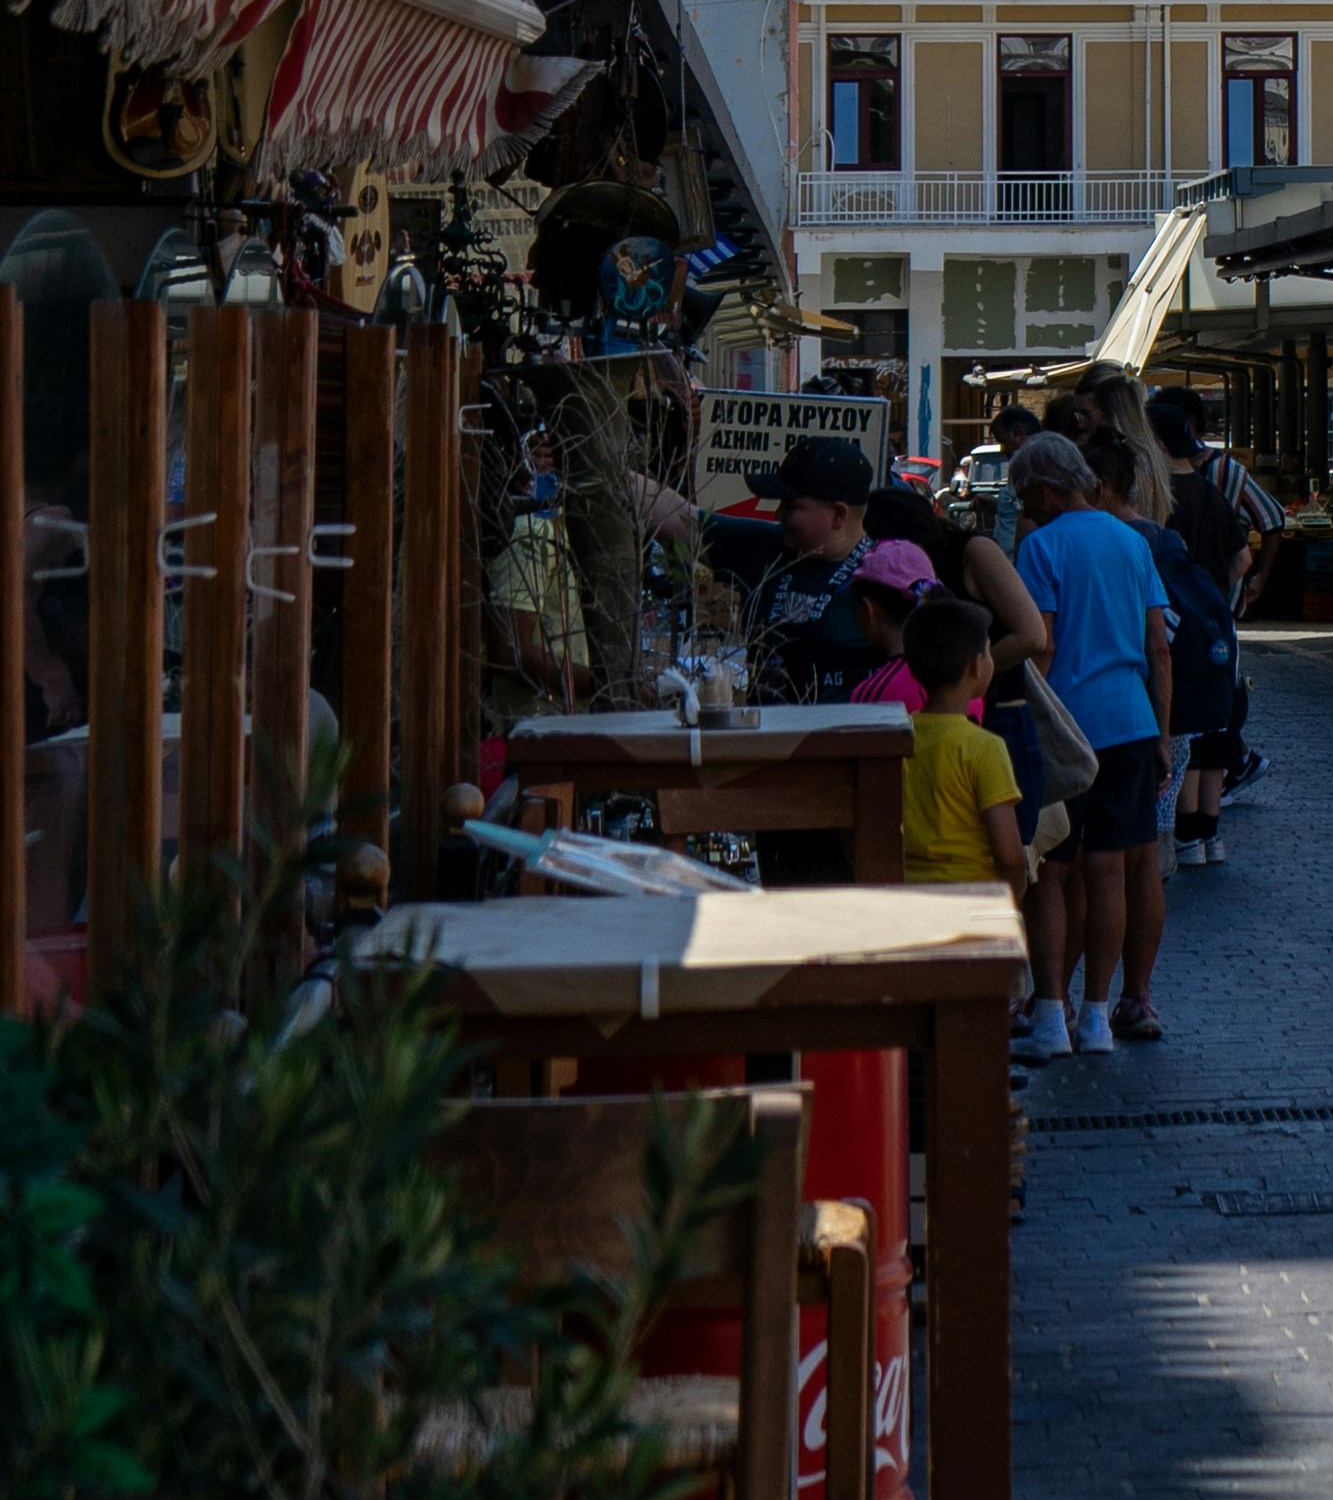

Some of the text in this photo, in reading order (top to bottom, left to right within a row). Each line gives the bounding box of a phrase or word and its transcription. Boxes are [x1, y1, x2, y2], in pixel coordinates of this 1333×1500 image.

[710, 399, 872, 432] ΑΓΟΡΑ ΧΡΥΣΟΥ
[711, 429, 769, 452] ΑΣΗΜΙ
